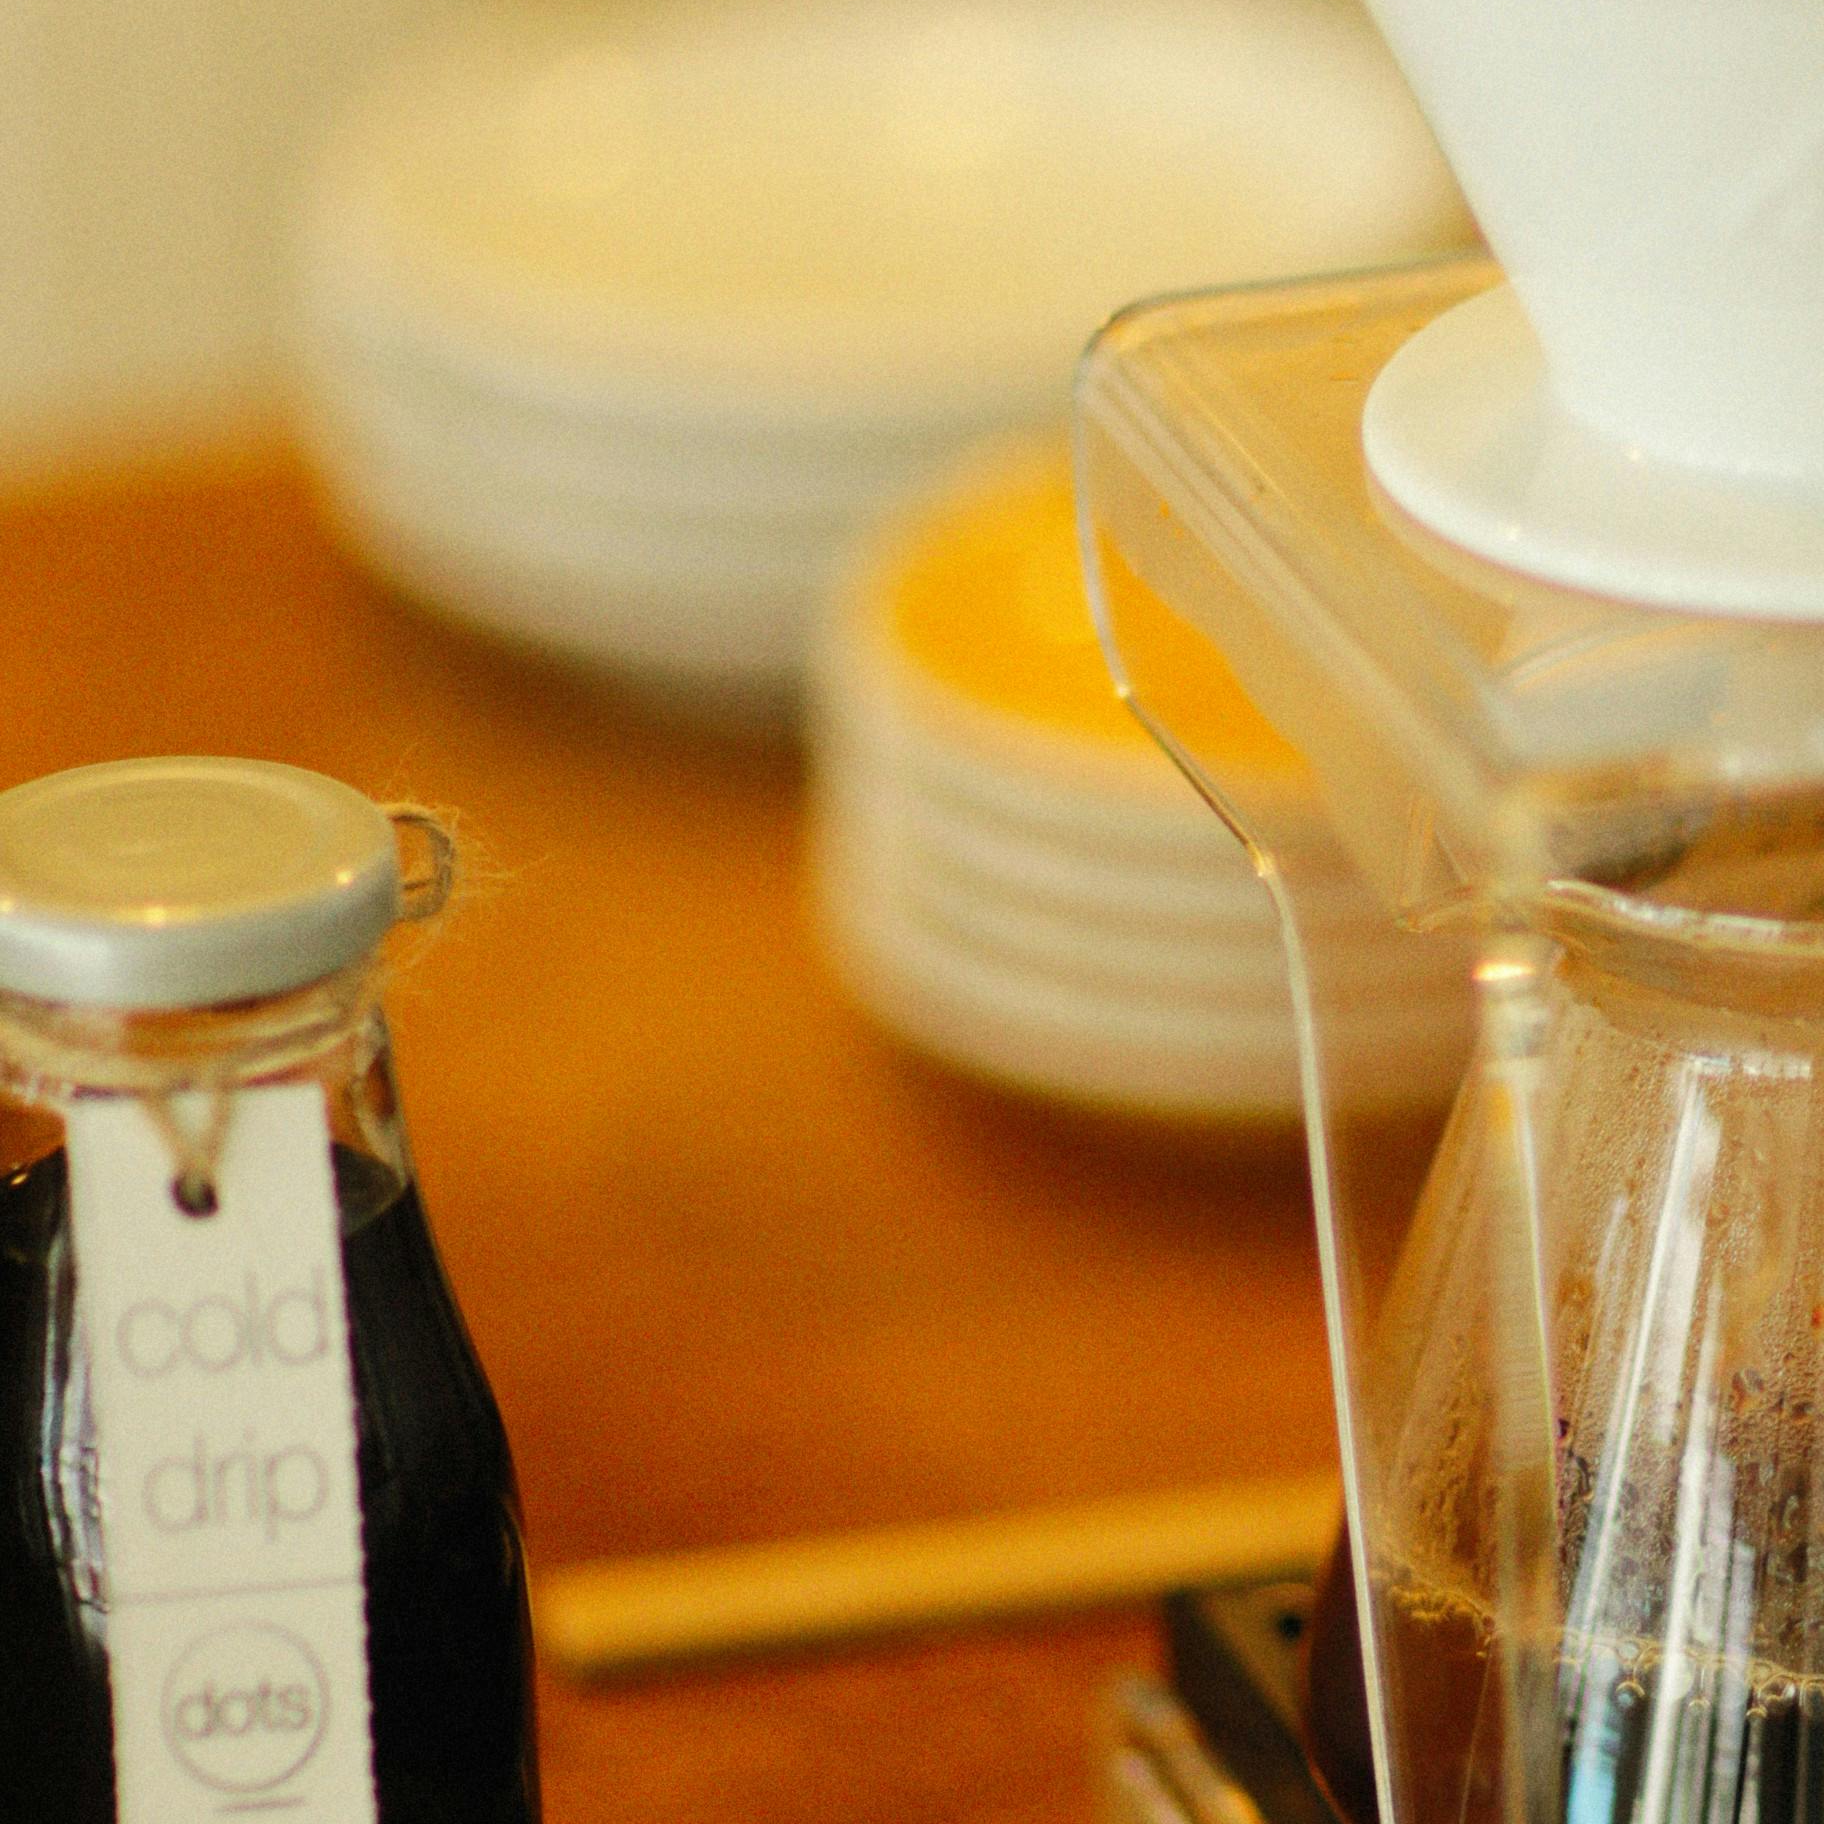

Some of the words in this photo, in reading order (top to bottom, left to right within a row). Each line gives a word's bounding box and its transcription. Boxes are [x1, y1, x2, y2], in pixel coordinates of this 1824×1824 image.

[116, 1265, 332, 1378] cold
[142, 1428, 328, 1543] drip
[173, 1676, 311, 1740] dots
